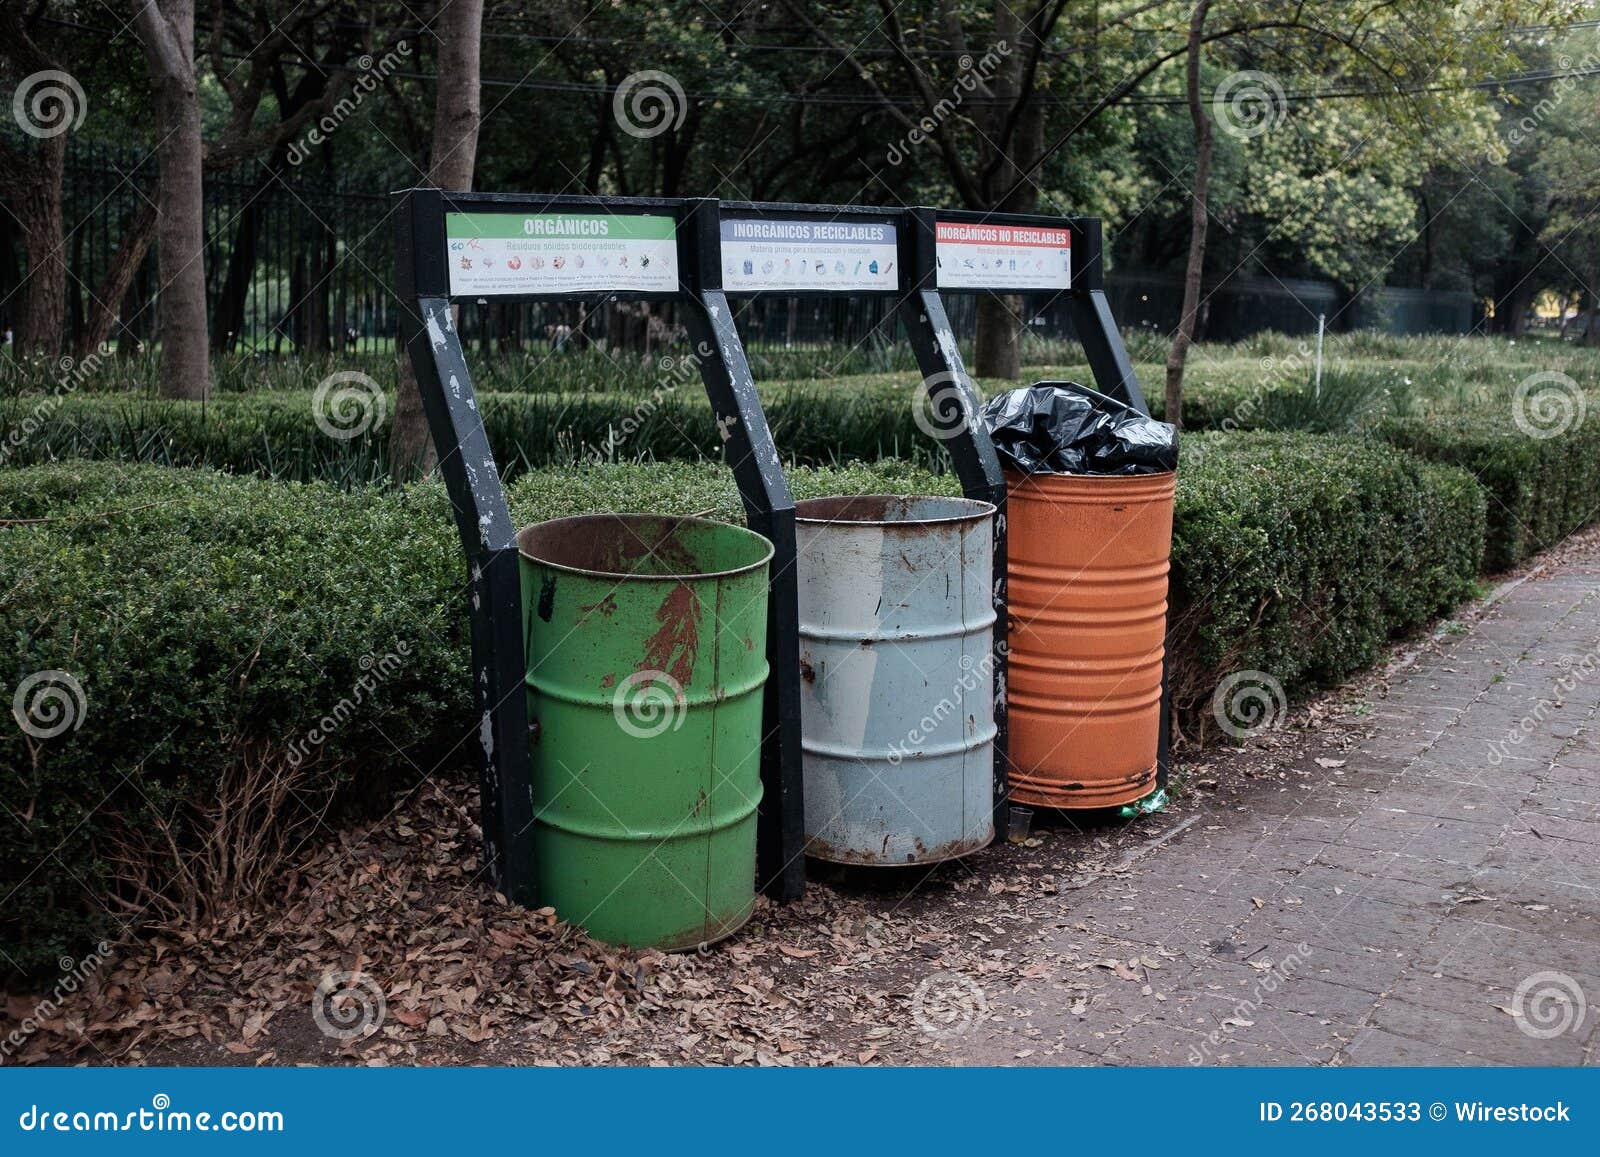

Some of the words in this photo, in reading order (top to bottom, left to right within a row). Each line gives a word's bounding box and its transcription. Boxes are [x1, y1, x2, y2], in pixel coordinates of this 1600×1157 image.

[523, 215, 609, 236] ORGÁNICOS
[733, 222, 810, 239] INORGÁNICOS
[813, 225, 884, 241] RECICLABLES
[937, 226, 998, 242] INORGÁNICOS
[999, 230, 1011, 242] NO
[1013, 231, 1067, 244] RECICLABLES
